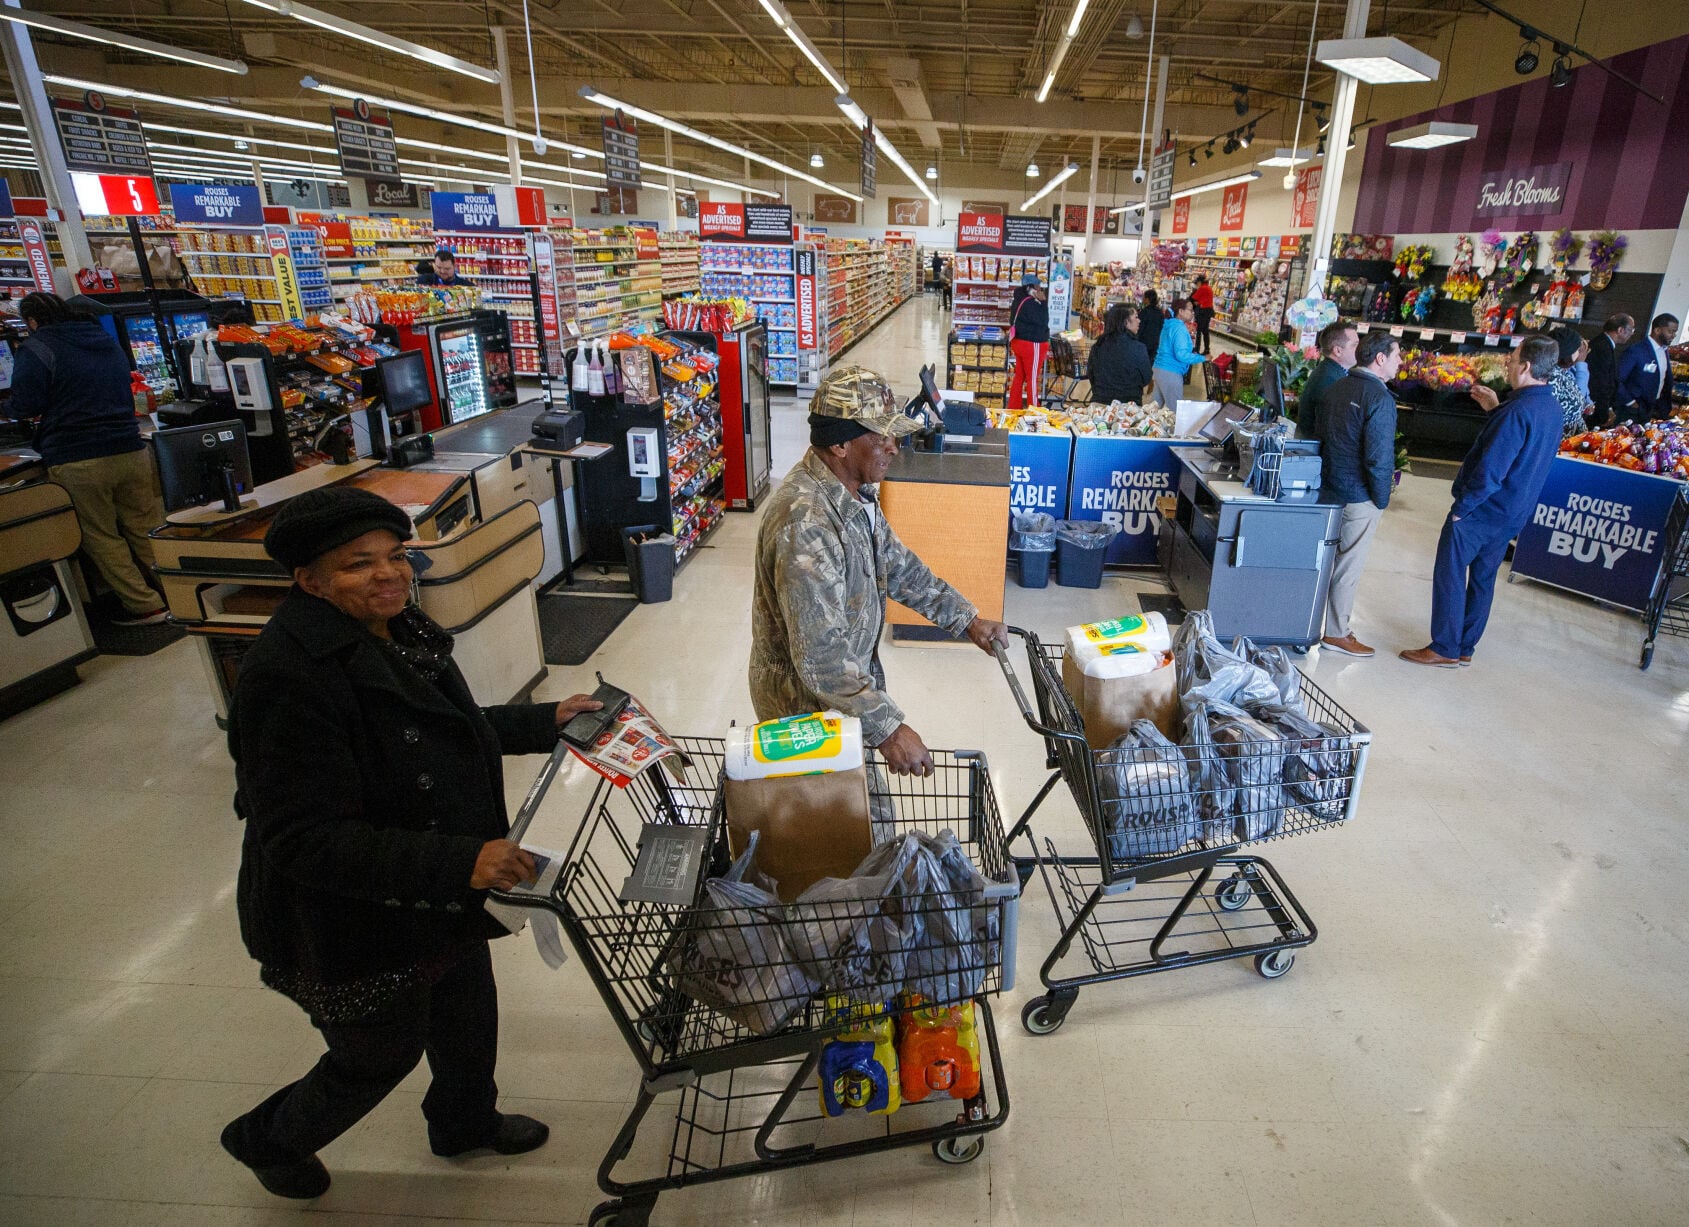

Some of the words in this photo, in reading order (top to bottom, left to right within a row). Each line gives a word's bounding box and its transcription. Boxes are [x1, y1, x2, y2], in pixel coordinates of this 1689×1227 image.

[91, 93, 100, 109] 5
[127, 178, 142, 212] 5
[204, 187, 230, 196] ROUSES
[374, 183, 411, 204] Local
[464, 195, 490, 204] ROUSES
[1477, 178, 1513, 209] Fresh
[1513, 175, 1561, 206] Blooms
[194, 195, 242, 206] REMARKABLE
[453, 202, 498, 215] REMARKABL
[532, 190, 541, 224] 6
[717, 204, 726, 214] AS
[205, 206, 234, 218] BUY
[464, 213, 494, 226] BUY
[702, 213, 742, 225] ADVERTISED
[977, 216, 987, 226] AS
[960, 225, 1001, 237] ADVERTISED
[278, 257, 293, 296] VALUE
[287, 300, 298, 319] EST
[800, 278, 814, 333] ADVERTISED
[801, 333, 814, 346] AS
[1111, 470, 1170, 489] ROUSES
[1566, 492, 1632, 522] ROUSES
[1101, 511, 1162, 536] BUY
[1532, 503, 1659, 555] REMARKABLE
[1547, 530, 1629, 570] BUY
